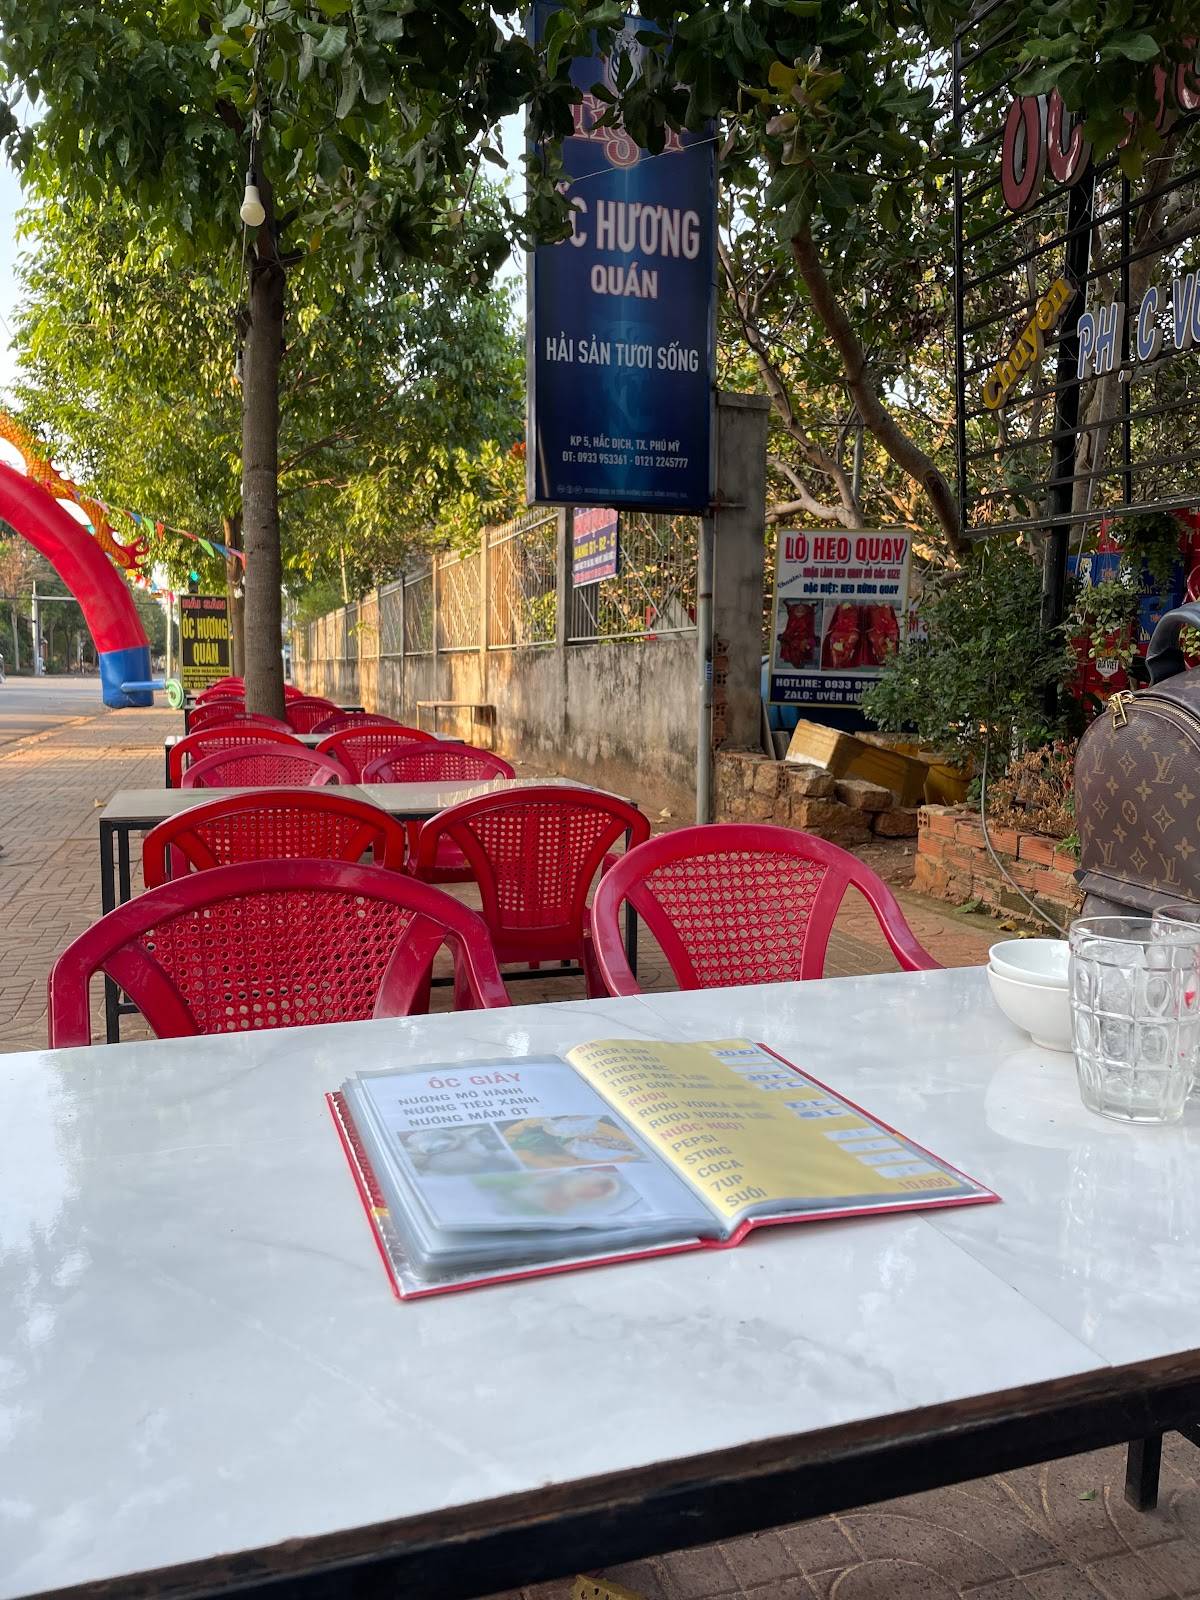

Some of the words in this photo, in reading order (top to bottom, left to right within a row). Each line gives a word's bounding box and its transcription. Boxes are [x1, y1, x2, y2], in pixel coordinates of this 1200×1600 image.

[597, 199, 700, 260] HƯƠNG
[590, 261, 658, 299] QUÁN
[546, 331, 574, 363] HẢI
[578, 334, 611, 366] SẢN
[616, 343, 653, 369] TƯƠI
[657, 341, 699, 372] SỐNG
[570, 435, 582, 446] KP
[577, 451, 598, 463] 0933
[599, 453, 628, 465] 953361
[635, 455, 654, 466] 0121
[785, 533, 808, 562] LÒ
[813, 537, 849, 563] HEO
[856, 537, 906, 565] QUAY
[182, 610, 195, 640] ỐC
[197, 616, 229, 640] HƯƠNG
[193, 639, 219, 666] QUÁN
[776, 677, 822, 690] HOTLINE:
[784, 689, 813, 701] ZALO:
[583, 1048, 619, 1061] TIGER
[592, 1056, 630, 1069] TIGER
[600, 1064, 639, 1078] TIGER
[608, 1072, 648, 1087] TIGER
[500, 1096, 540, 1107] XANH
[681, 1099, 731, 1109] VODKA
[692, 1111, 744, 1120] VODKA
[671, 1134, 719, 1152] PEPSI
[683, 1146, 733, 1165] STING
[697, 1159, 745, 1178] COCA
[710, 1174, 744, 1192] 7UP
[898, 1176, 954, 1190] 10.000
